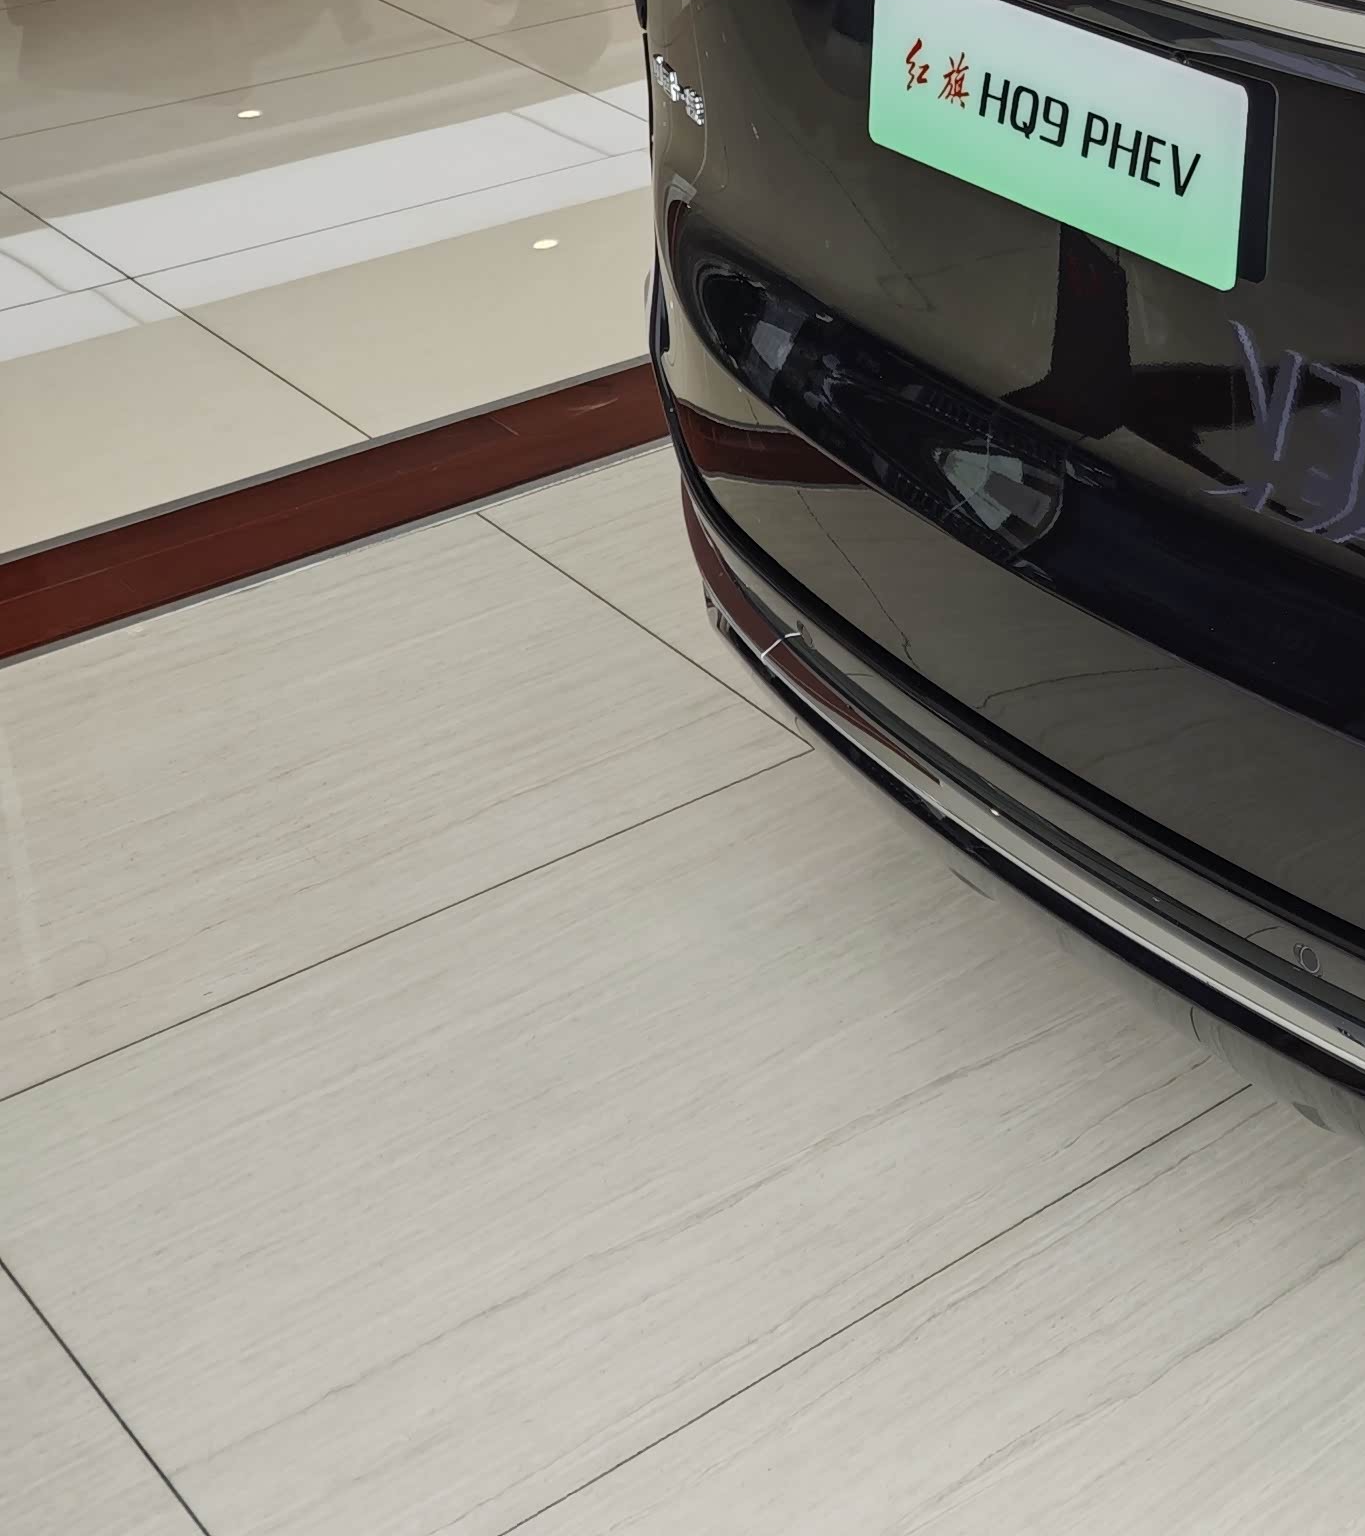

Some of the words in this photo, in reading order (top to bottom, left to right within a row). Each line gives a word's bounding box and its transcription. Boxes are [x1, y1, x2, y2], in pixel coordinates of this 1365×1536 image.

[906, 38, 970, 109] 红旗
[978, 72, 1069, 148] HQ9
[1081, 111, 1201, 197] PHEV
